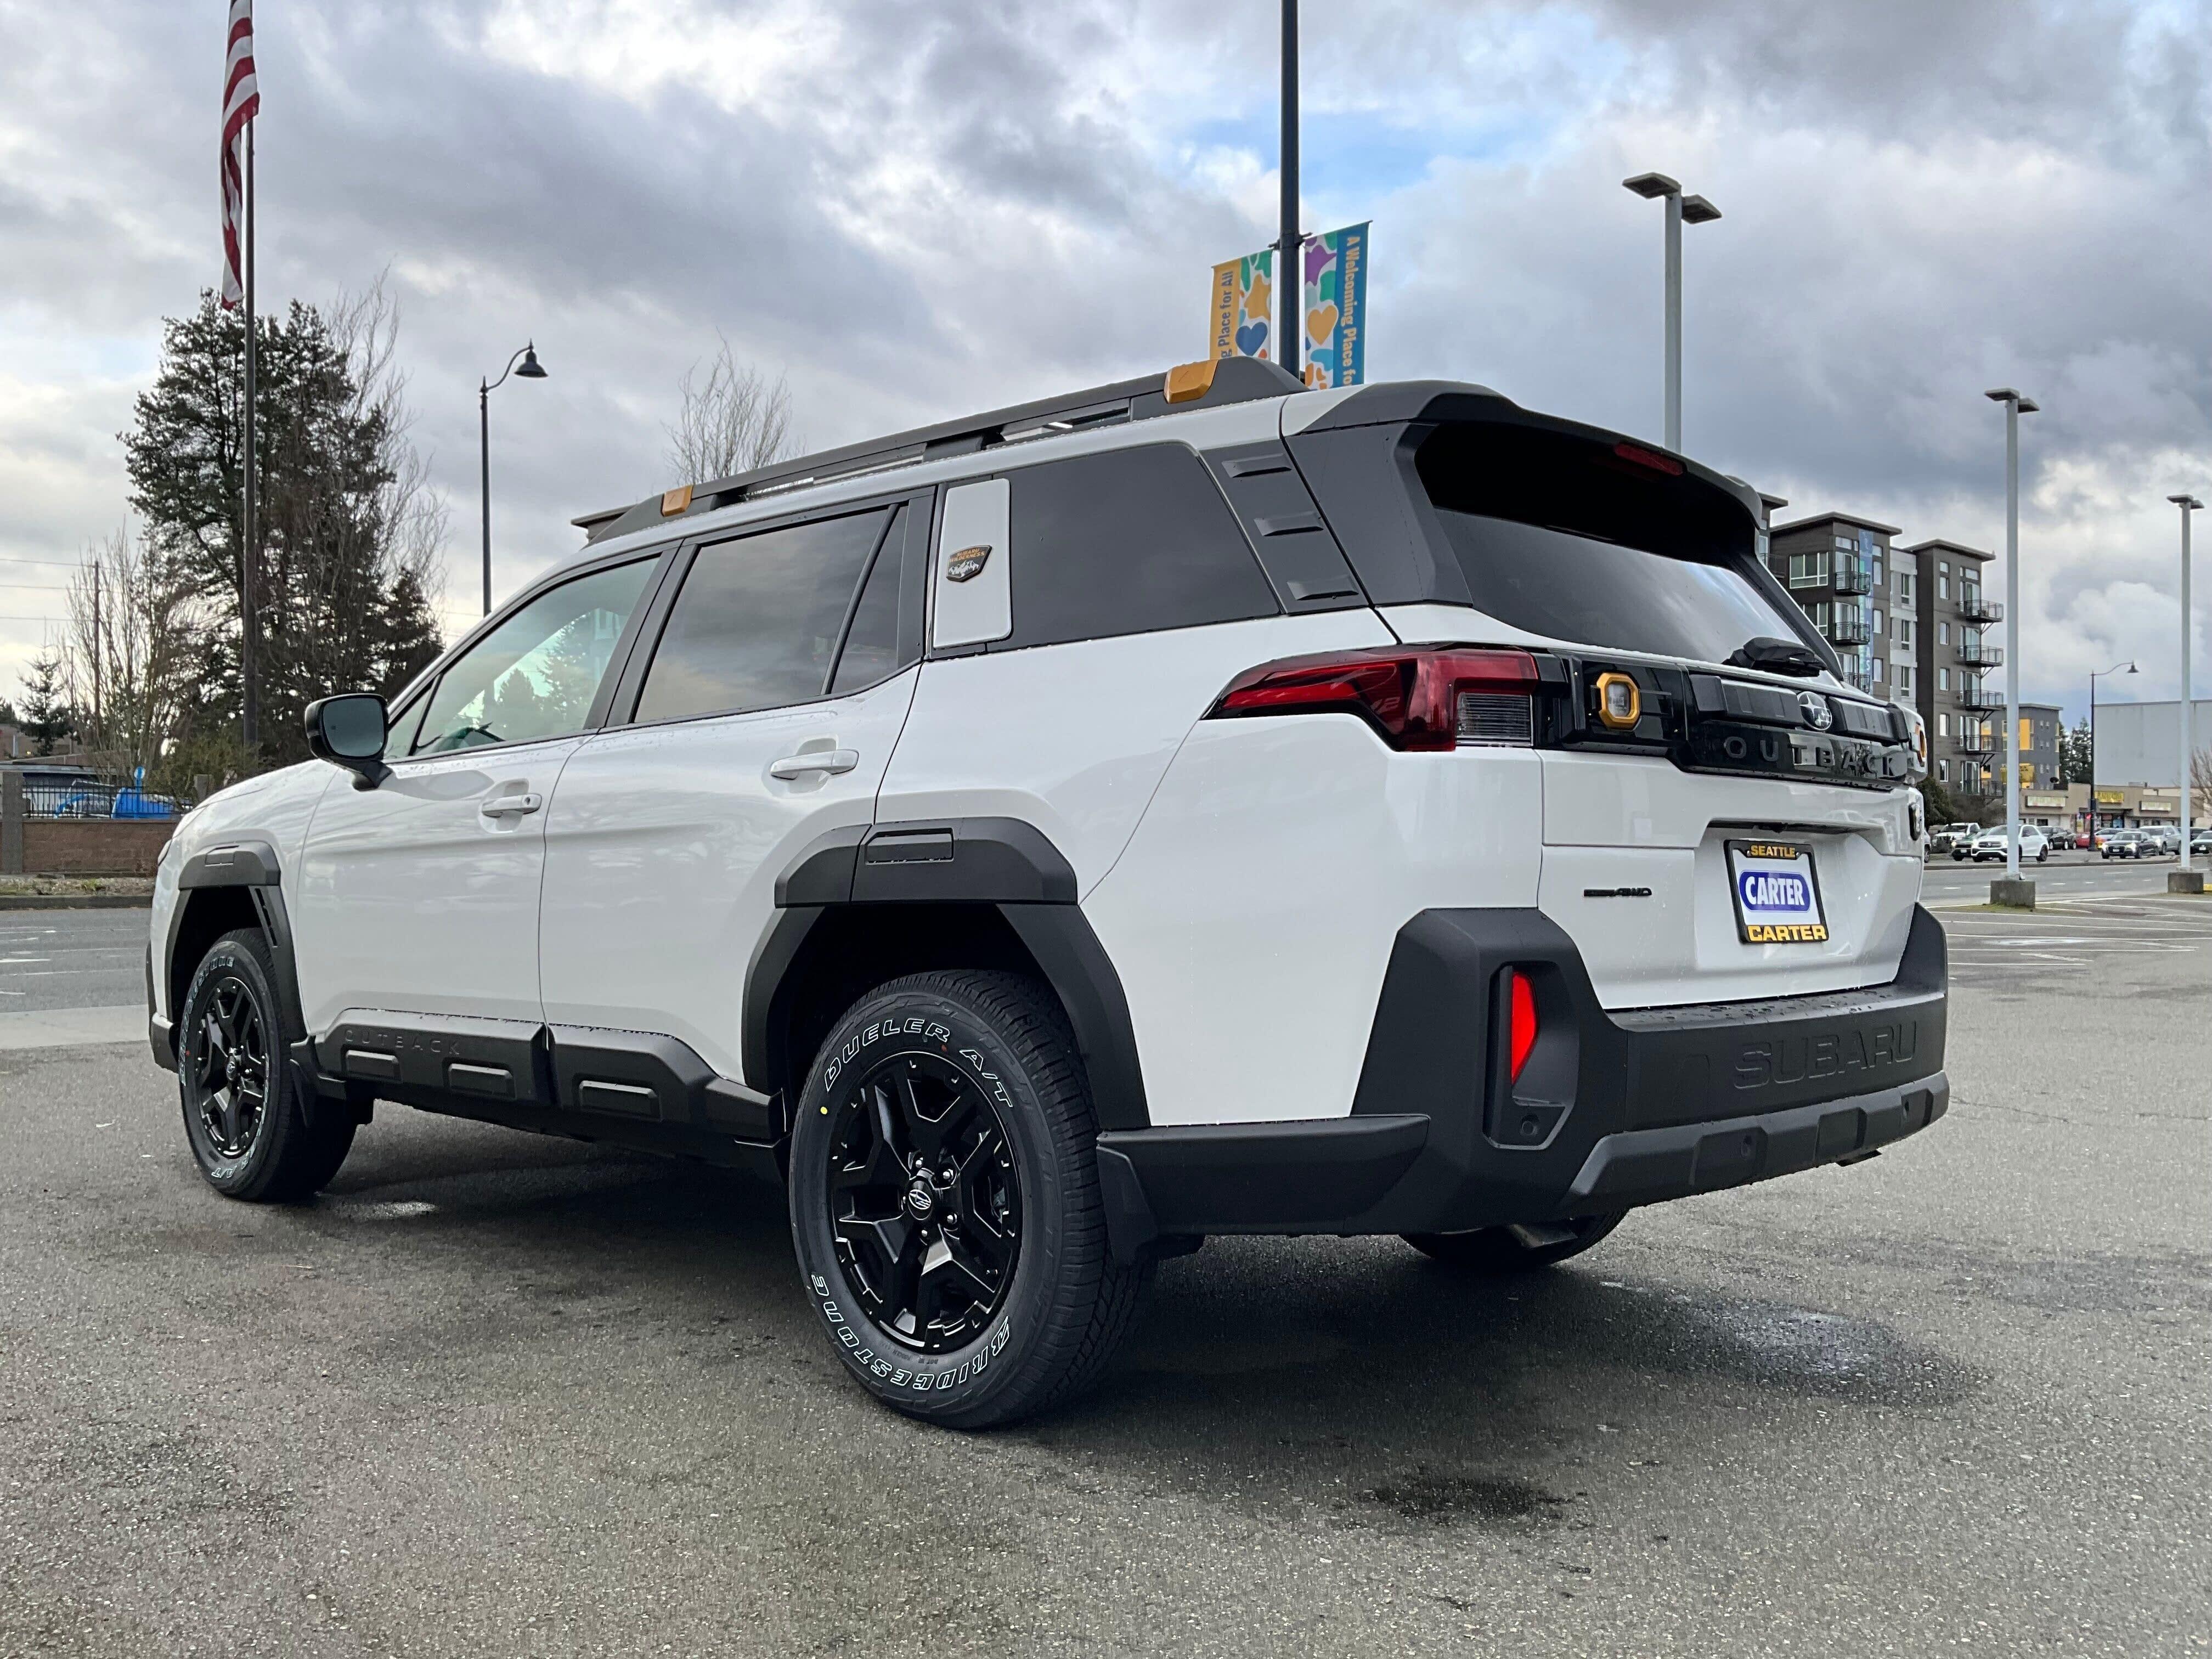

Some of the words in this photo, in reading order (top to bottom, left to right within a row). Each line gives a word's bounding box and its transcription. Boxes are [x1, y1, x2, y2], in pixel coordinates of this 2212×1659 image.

[1347, 237, 1361, 246] A
[1222, 270, 1233, 286] All
[1341, 246, 1359, 326] Welcoming
[1220, 290, 1232, 310] for
[1218, 311, 1231, 347] Place
[1342, 328, 1357, 367] Place
[1343, 369, 1356, 386] fo
[1725, 736, 1897, 776] OUTBACK
[1750, 845, 1796, 857] SEATTLE
[1745, 876, 1805, 906] CARTER
[1747, 925, 1827, 941] CARTER
[824, 1018, 950, 1093] DUELER
[959, 1049, 1013, 1108] A/T
[1733, 1020, 1917, 1090] SUBARU
[811, 1274, 1010, 1391] BRIDGESTONE
